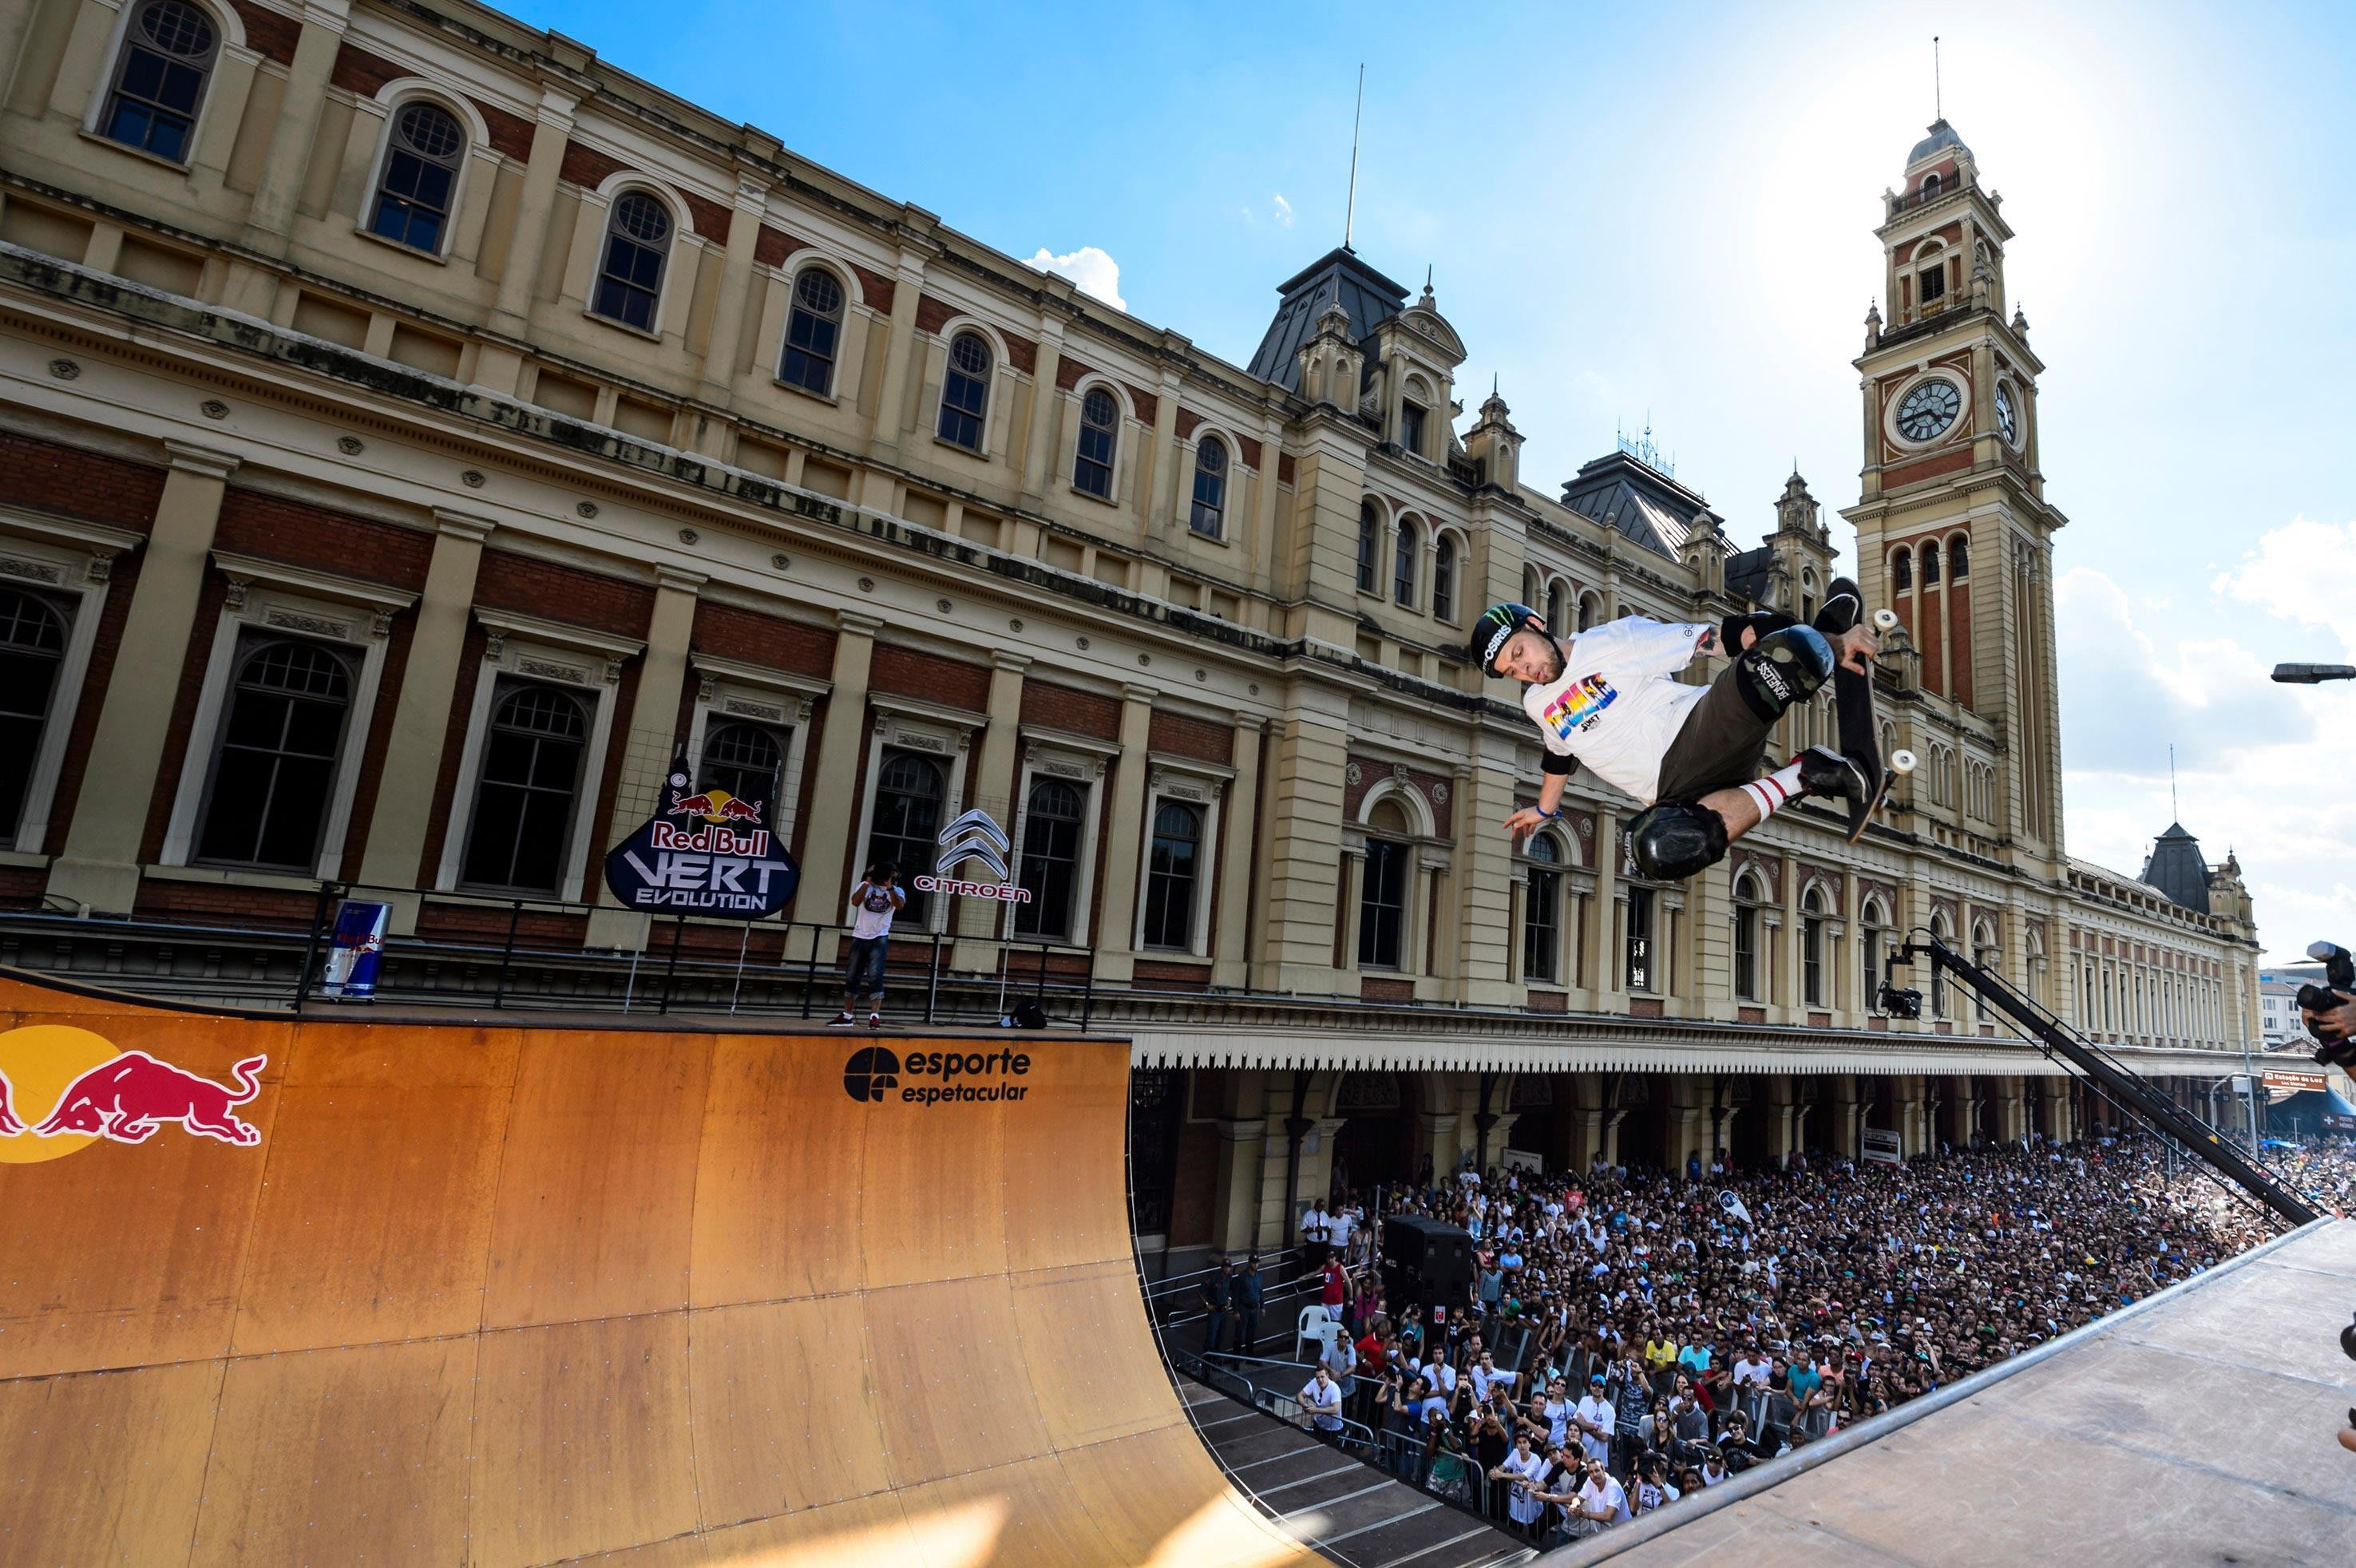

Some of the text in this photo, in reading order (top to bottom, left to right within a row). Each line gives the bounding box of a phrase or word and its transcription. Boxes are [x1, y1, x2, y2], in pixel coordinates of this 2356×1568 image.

[1485, 624, 1512, 660] OSIRIS
[1757, 661, 1790, 700] BONELESS
[651, 821, 769, 857] Red Bull
[623, 849, 790, 893] VERT
[636, 888, 766, 910] EVOLUTION
[905, 1047, 1031, 1083] esporte
[901, 1082, 1028, 1107] espetacular
